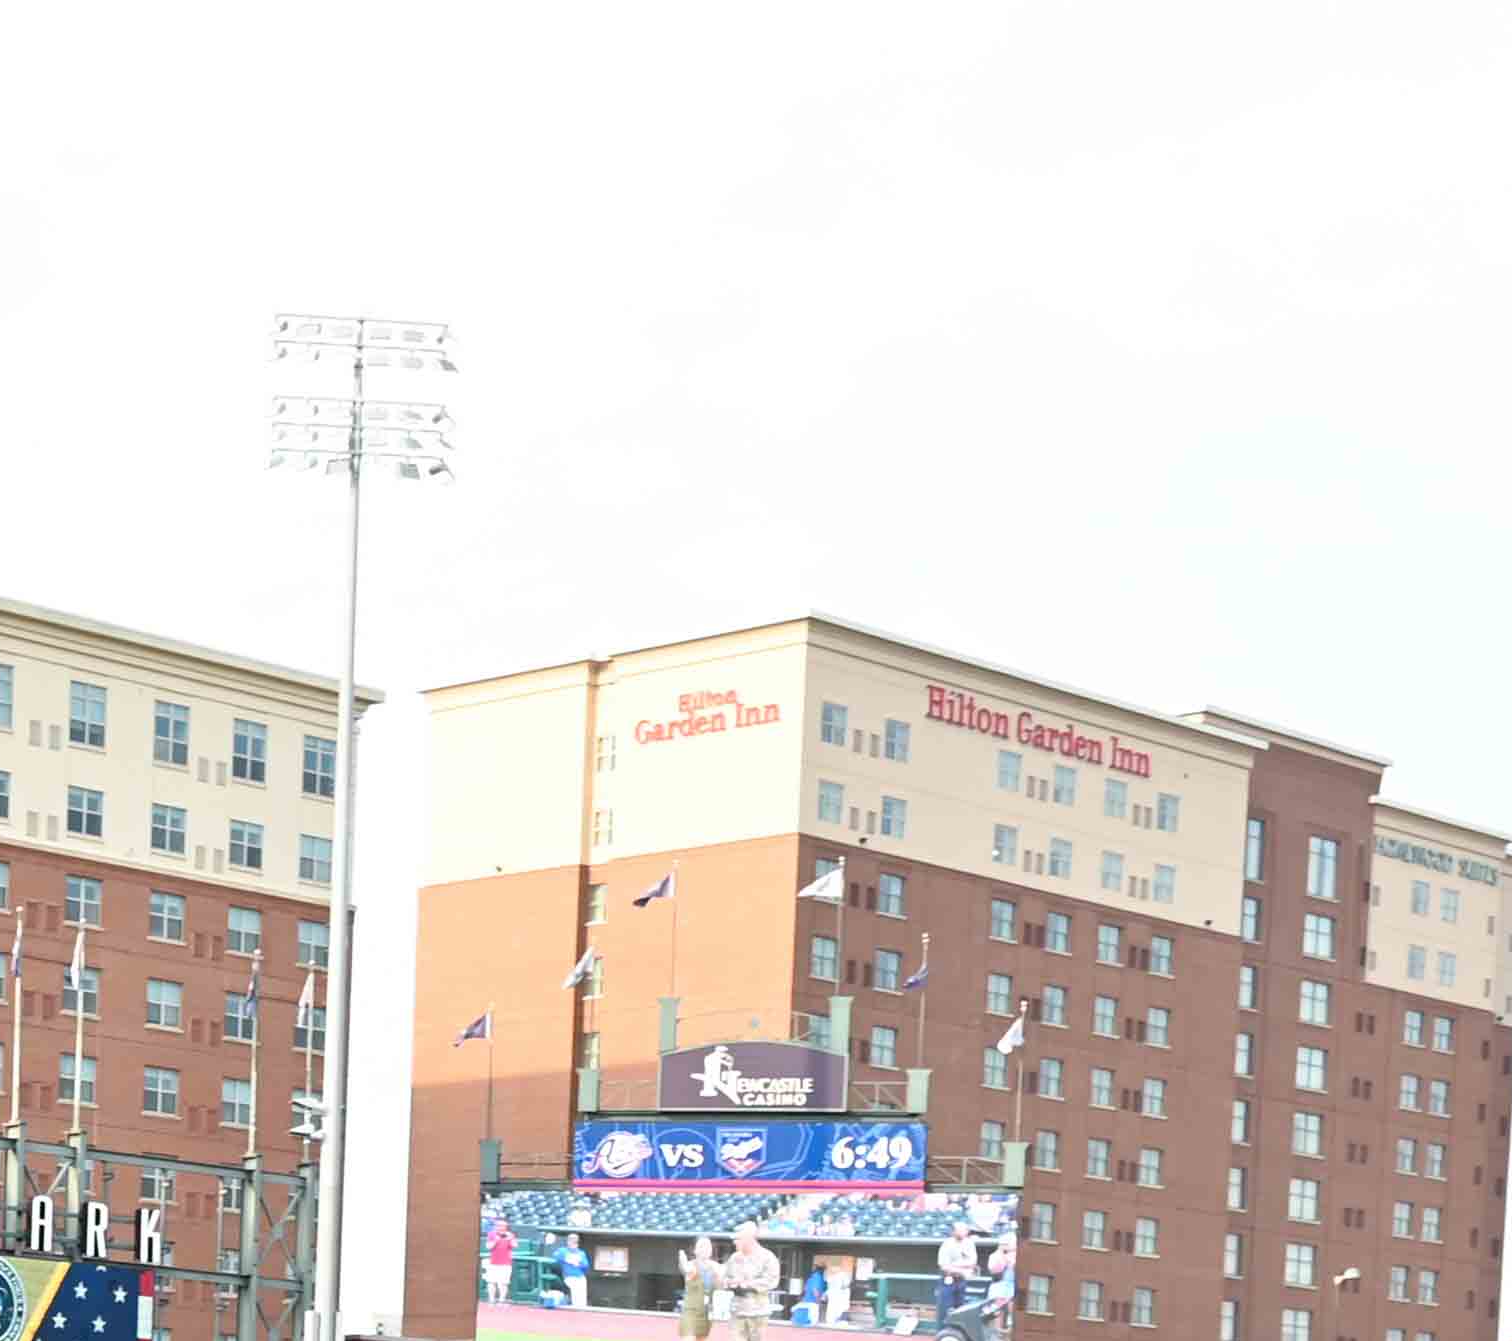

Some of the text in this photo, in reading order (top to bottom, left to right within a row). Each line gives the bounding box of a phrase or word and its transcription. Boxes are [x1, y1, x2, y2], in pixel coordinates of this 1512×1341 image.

[678, 689, 737, 712] Hilton
[633, 702, 780, 745] Garden Inn
[923, 684, 1153, 779] Hilton Garden Inn
[742, 1092, 808, 1106] CASINO
[831, 1135, 914, 1170] 6:49
